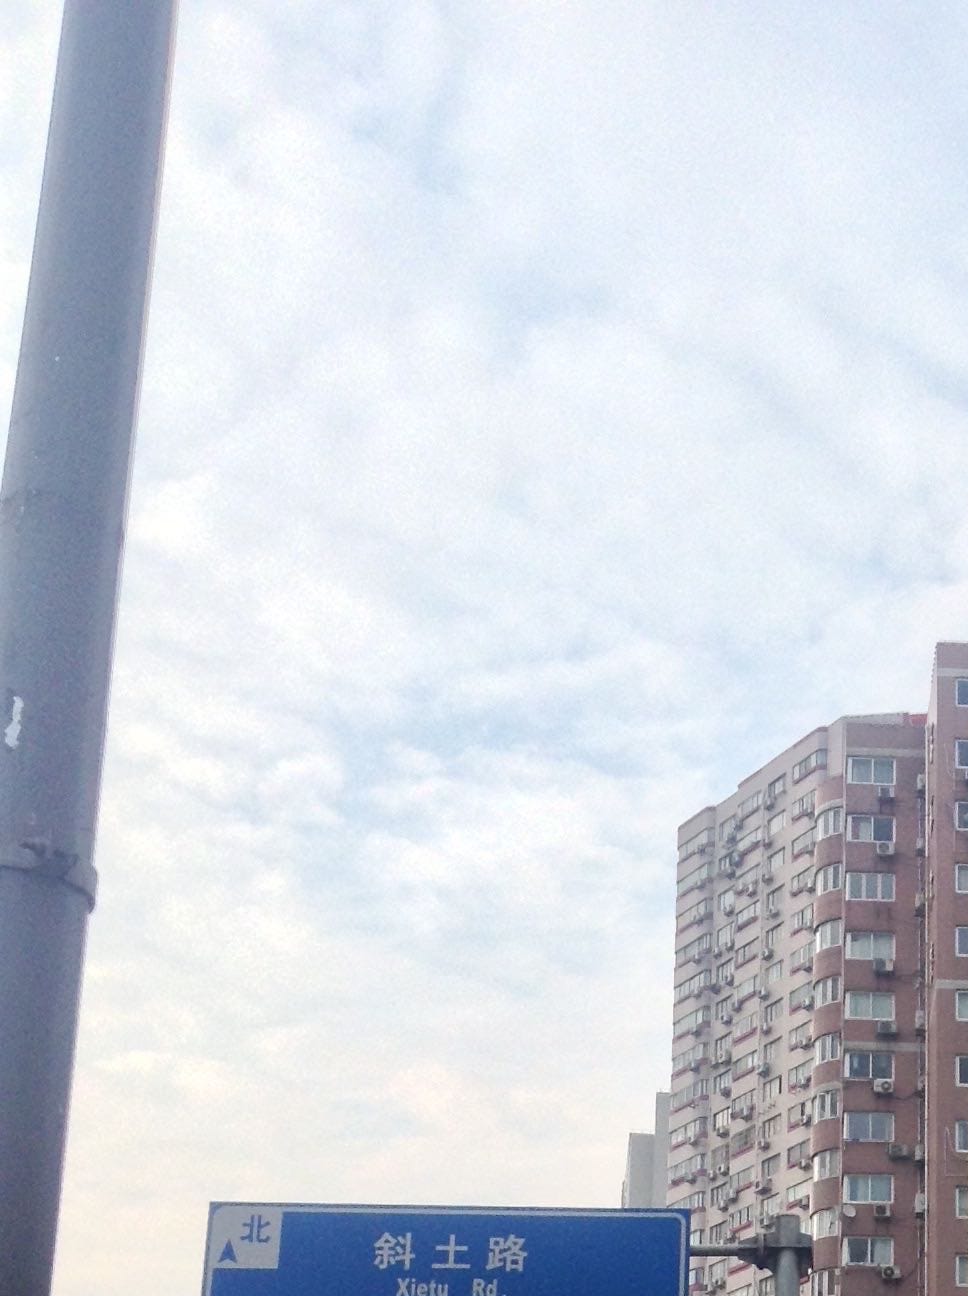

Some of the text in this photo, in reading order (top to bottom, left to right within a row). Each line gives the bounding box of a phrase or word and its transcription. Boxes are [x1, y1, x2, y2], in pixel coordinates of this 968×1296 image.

[240, 1214, 271, 1243] 北
[373, 1232, 528, 1272] 斜土路
